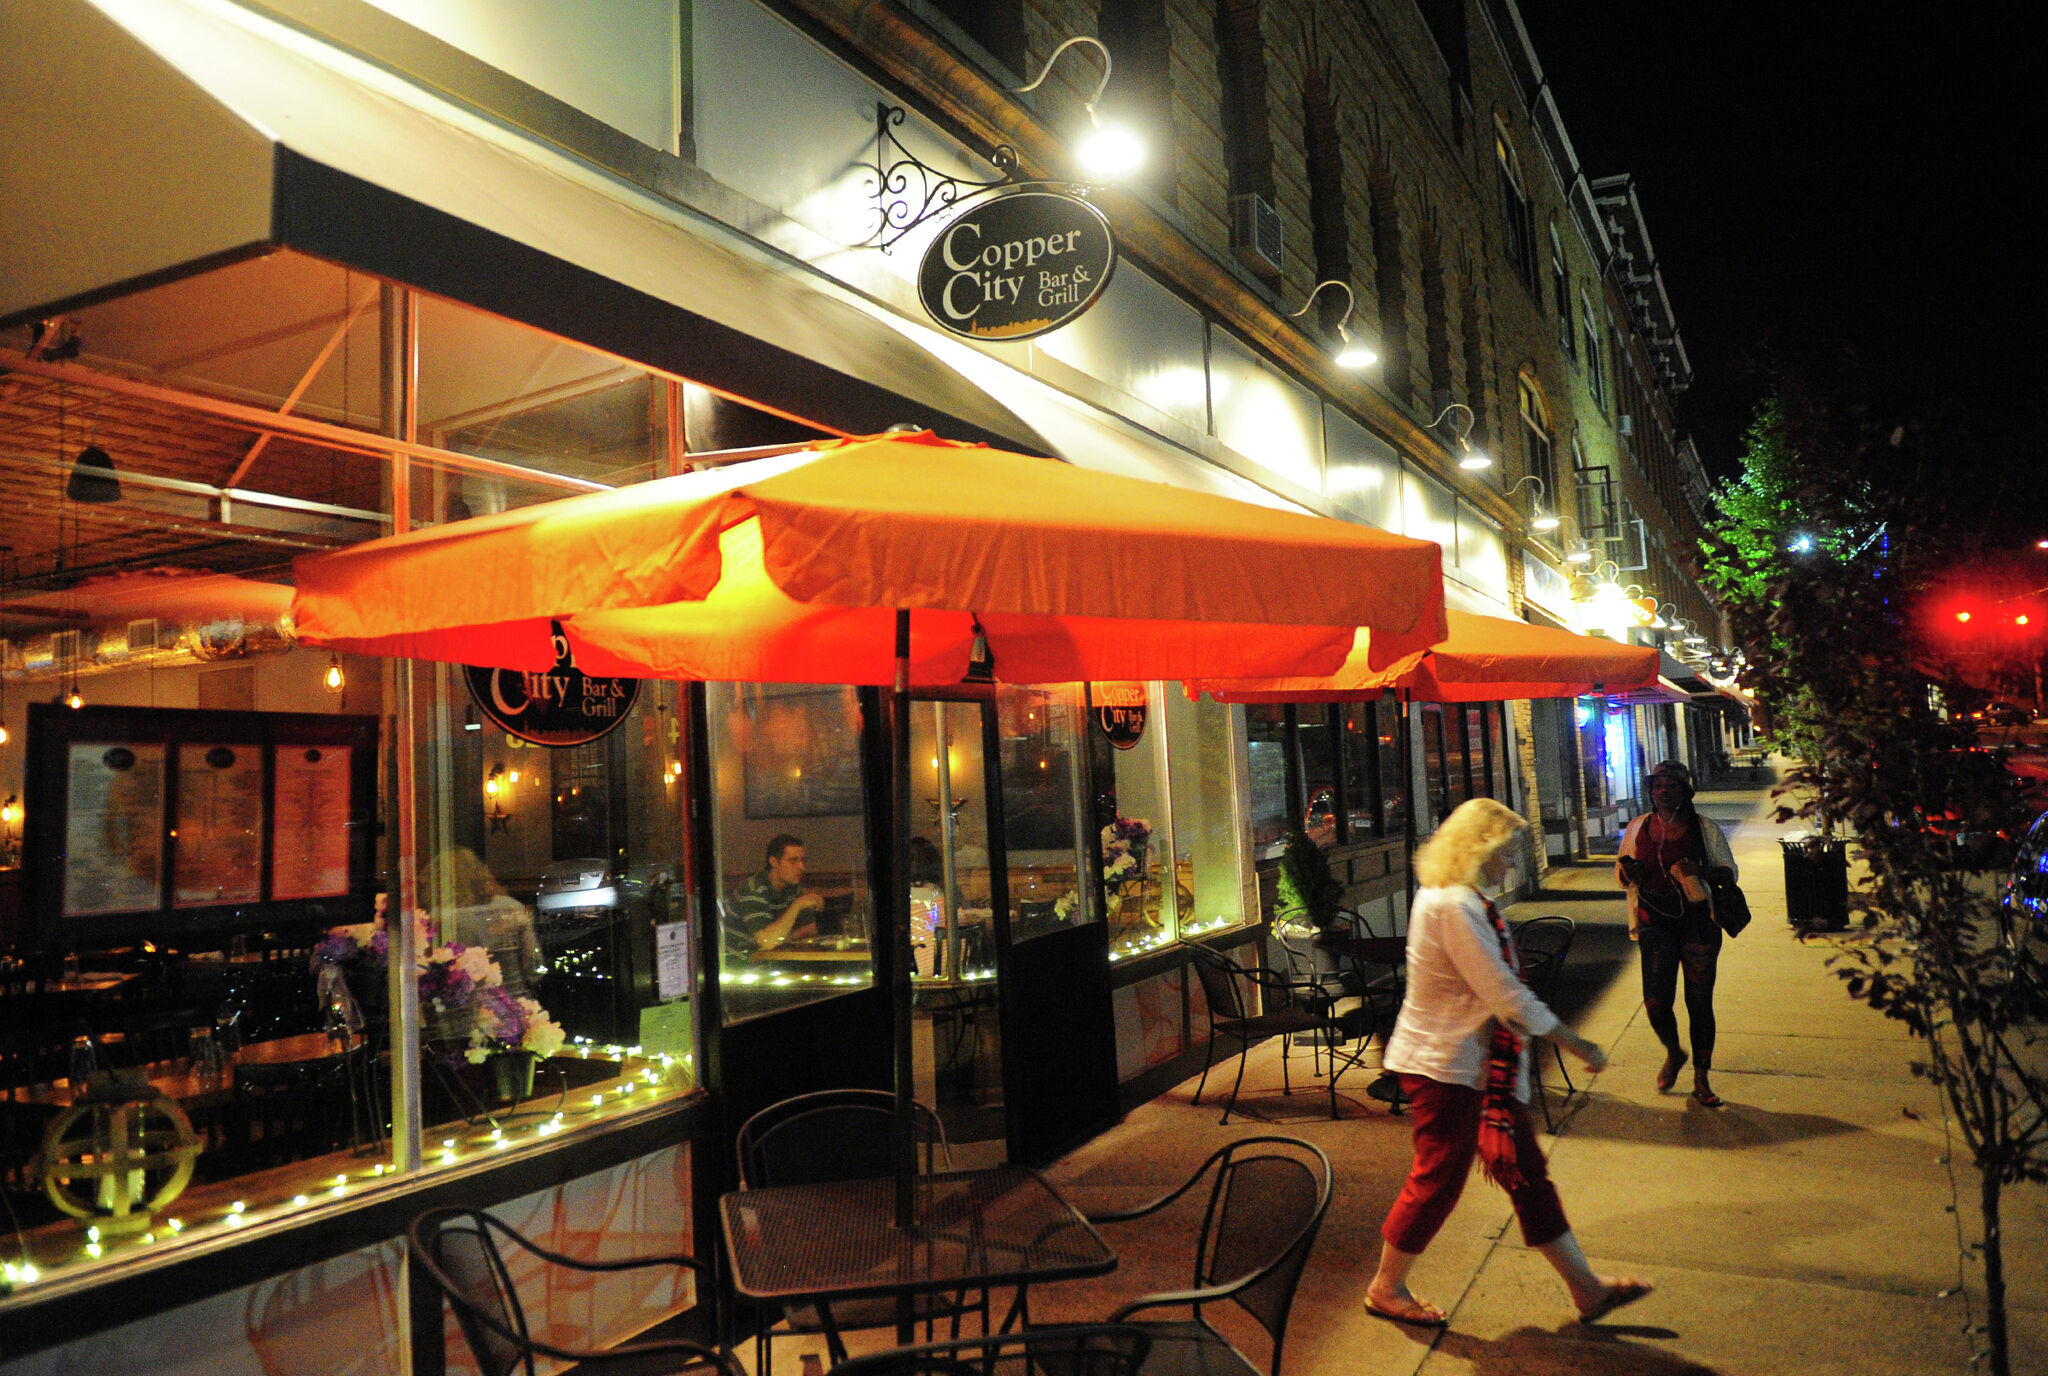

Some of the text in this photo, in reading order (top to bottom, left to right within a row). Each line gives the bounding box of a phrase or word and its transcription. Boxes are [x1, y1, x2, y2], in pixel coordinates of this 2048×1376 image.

[943, 223, 1081, 271] Copper
[1038, 264, 1092, 289] Bar &
[942, 271, 1025, 320] City
[1038, 283, 1080, 307] Grill
[490, 668, 570, 716] City
[581, 676, 626, 698] Bar &
[581, 697, 617, 717] Grill
[1101, 702, 1126, 732] City
